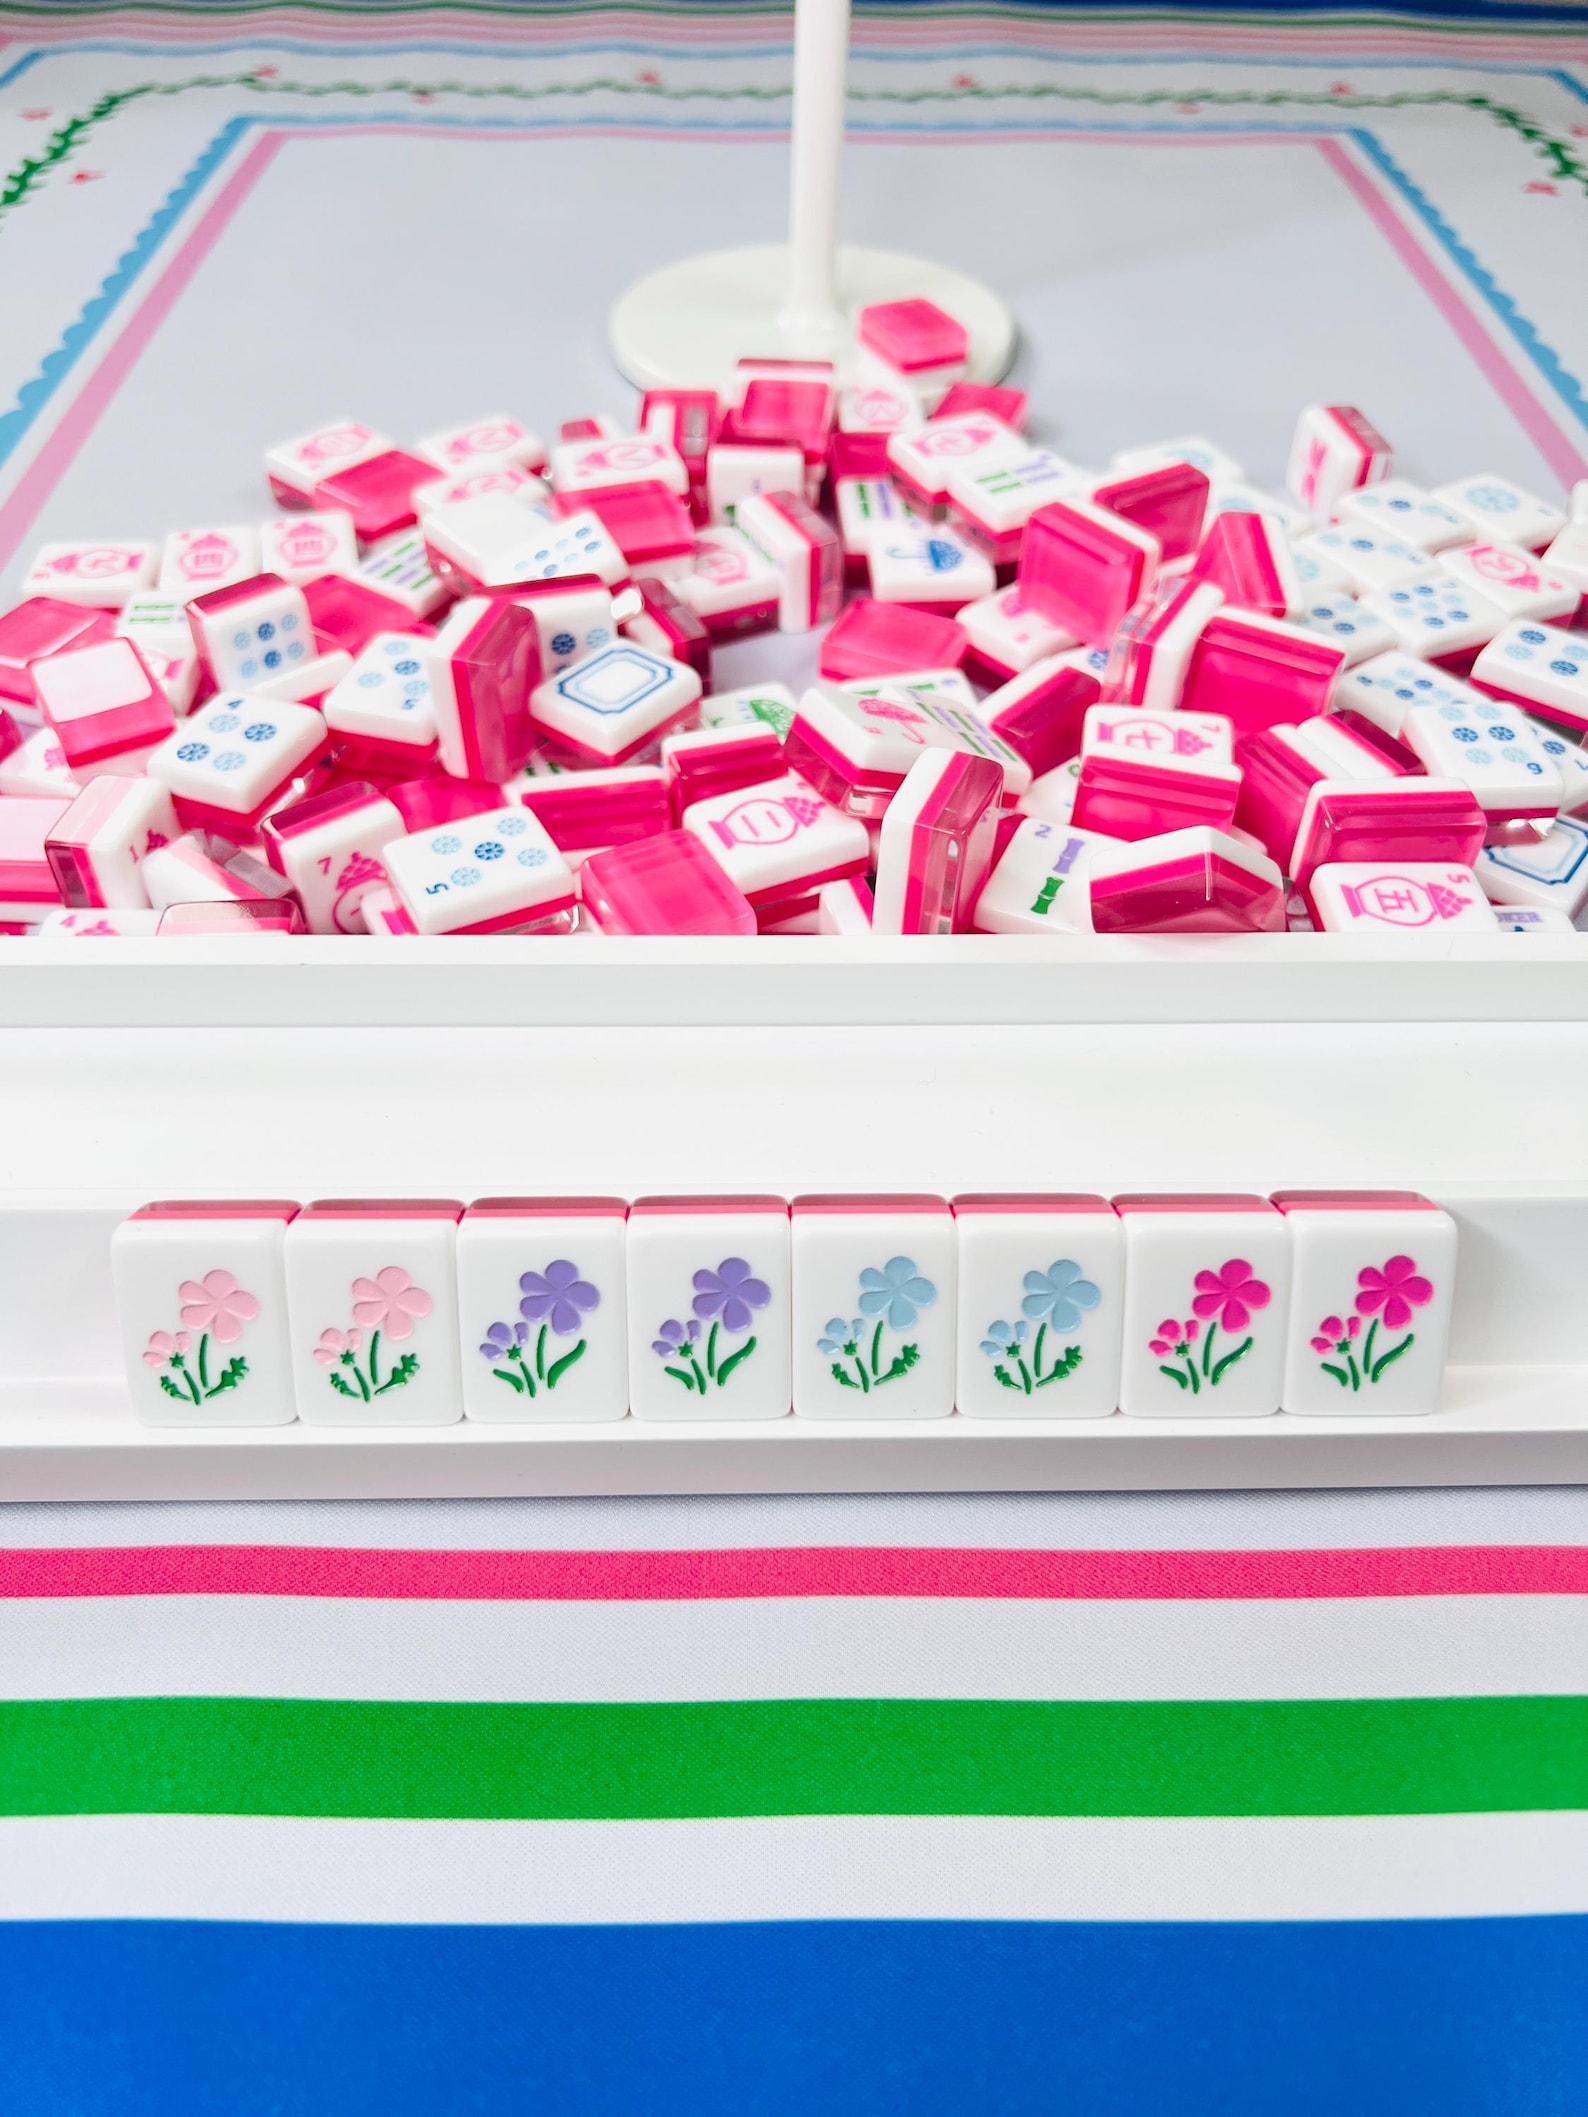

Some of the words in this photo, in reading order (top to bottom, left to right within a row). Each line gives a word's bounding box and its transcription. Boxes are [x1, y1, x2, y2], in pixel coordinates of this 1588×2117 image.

[227, 698, 244, 710] 4
[1200, 724, 1221, 734] 7
[1124, 728, 1163, 751] 七
[1526, 762, 1543, 775] 6
[1034, 824, 1052, 839] 2
[317, 856, 332, 876] 7
[1447, 873, 1471, 884] 5
[426, 882, 449, 896] 5
[1373, 888, 1420, 914] 五
[1499, 911, 1544, 923] KER
